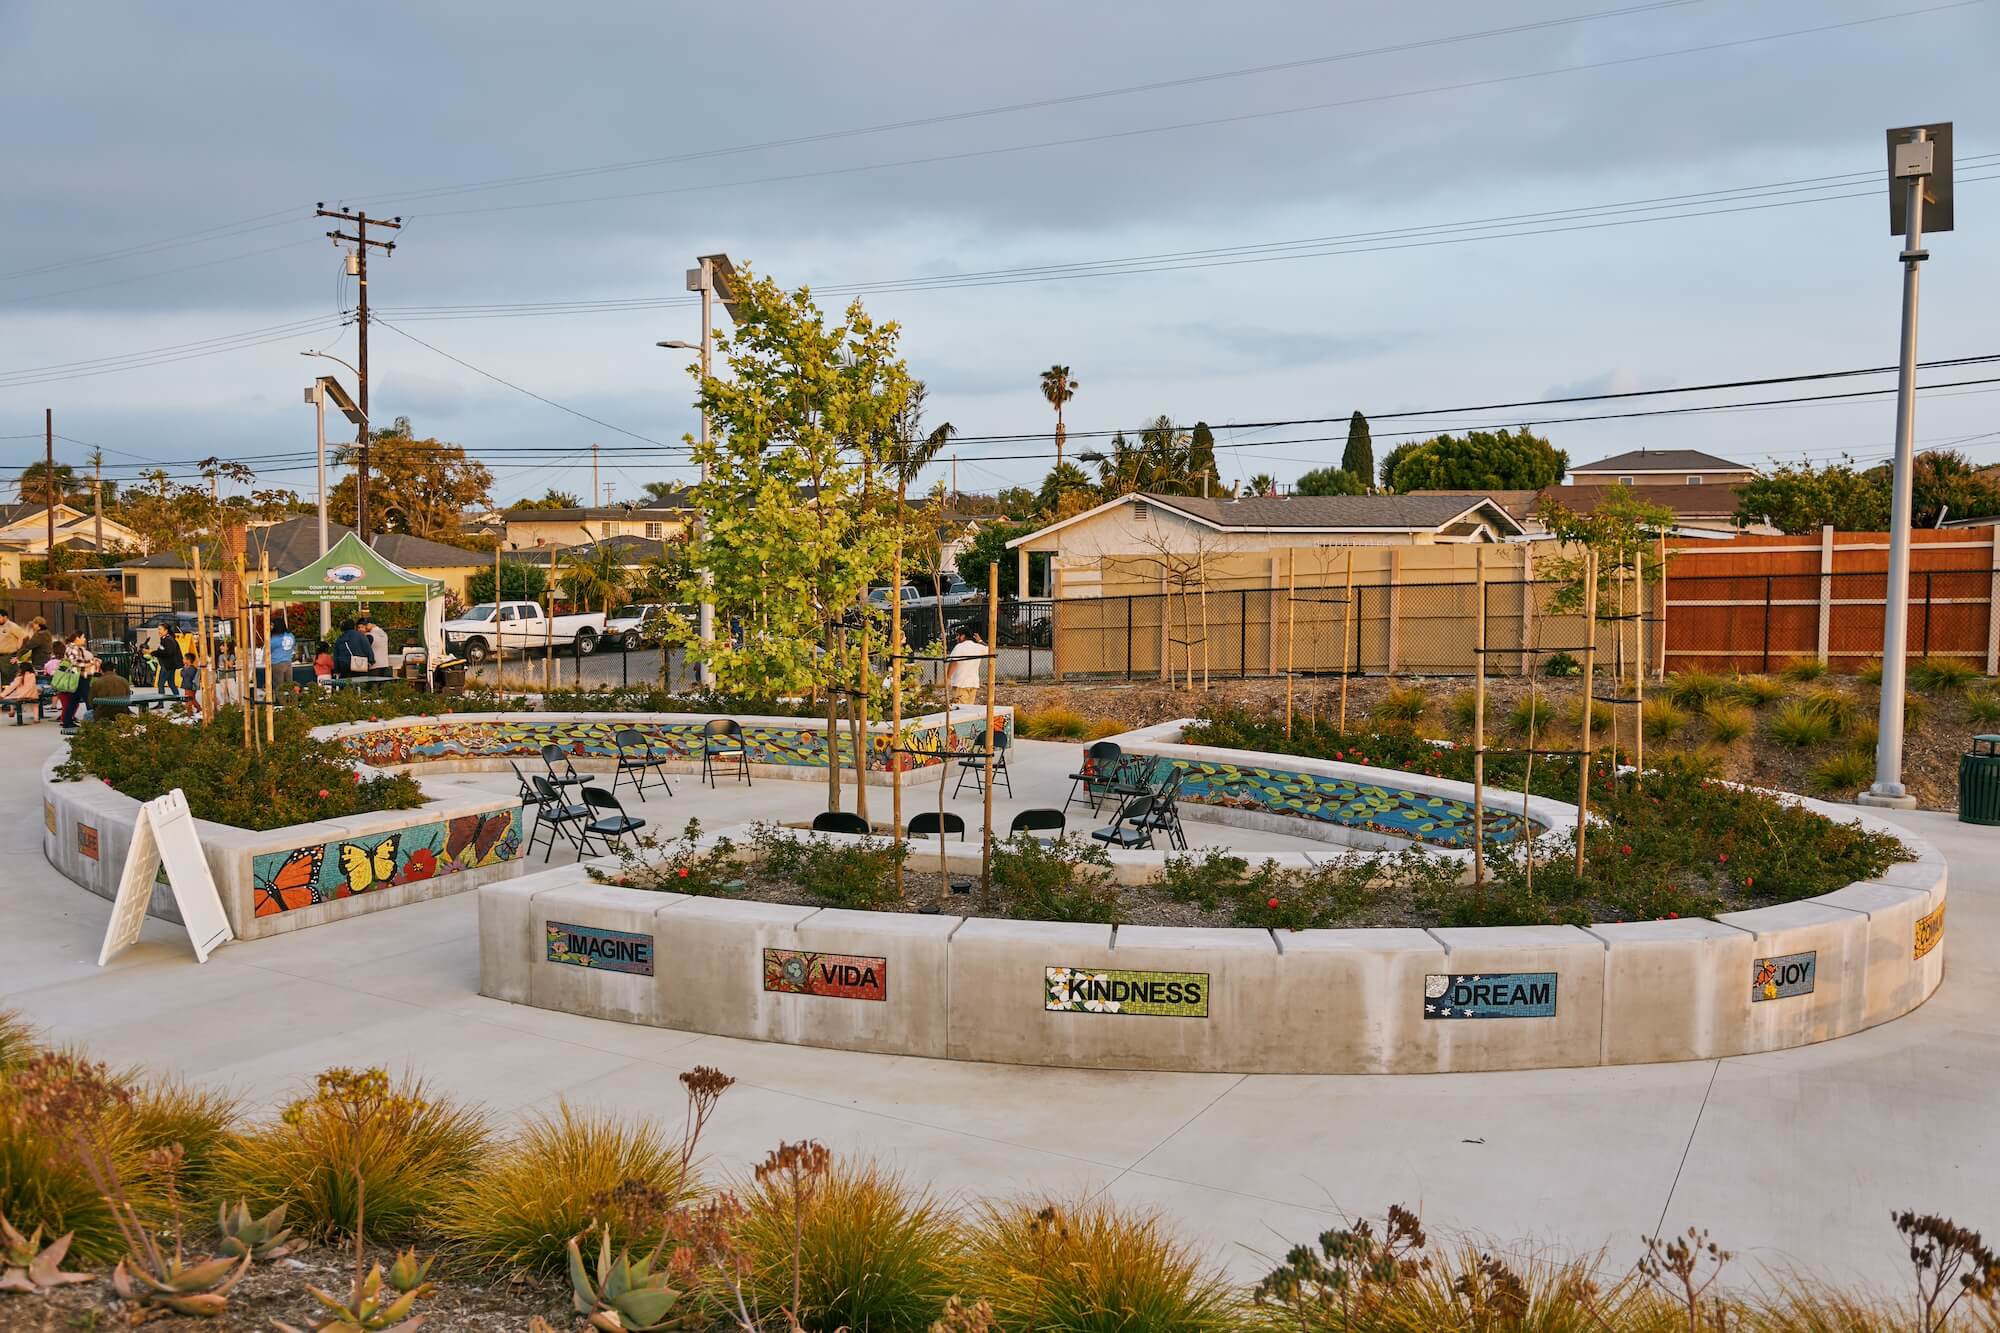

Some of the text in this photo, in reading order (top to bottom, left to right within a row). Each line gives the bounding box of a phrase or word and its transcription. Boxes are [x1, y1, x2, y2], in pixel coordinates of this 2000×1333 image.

[568, 933, 648, 963] IMAGINE
[820, 963, 879, 988] VIDA
[1775, 961, 1810, 987] JOY
[1068, 979, 1201, 1004] KINDNESS
[1454, 983, 1550, 1006] DREAM
